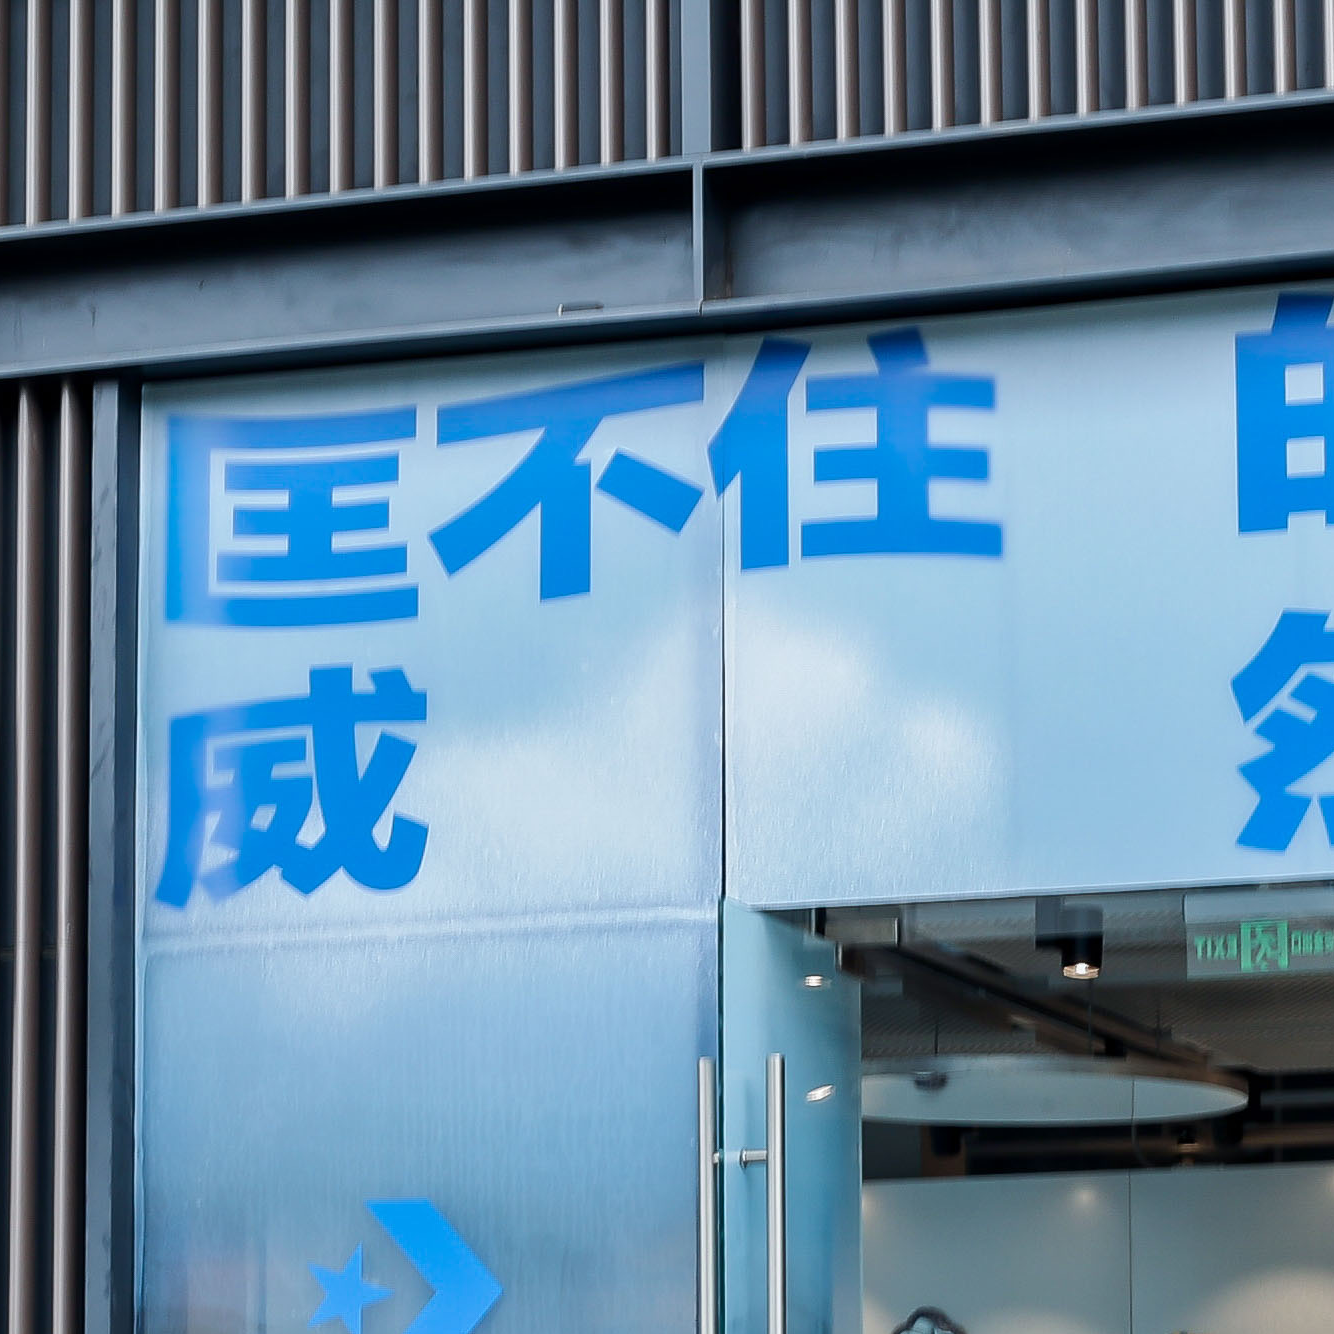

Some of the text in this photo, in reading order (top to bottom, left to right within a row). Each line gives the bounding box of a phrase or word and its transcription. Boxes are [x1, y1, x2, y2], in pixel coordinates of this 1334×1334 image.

[165, 325, 1003, 628] 匡不住
[154, 664, 430, 909] 威
